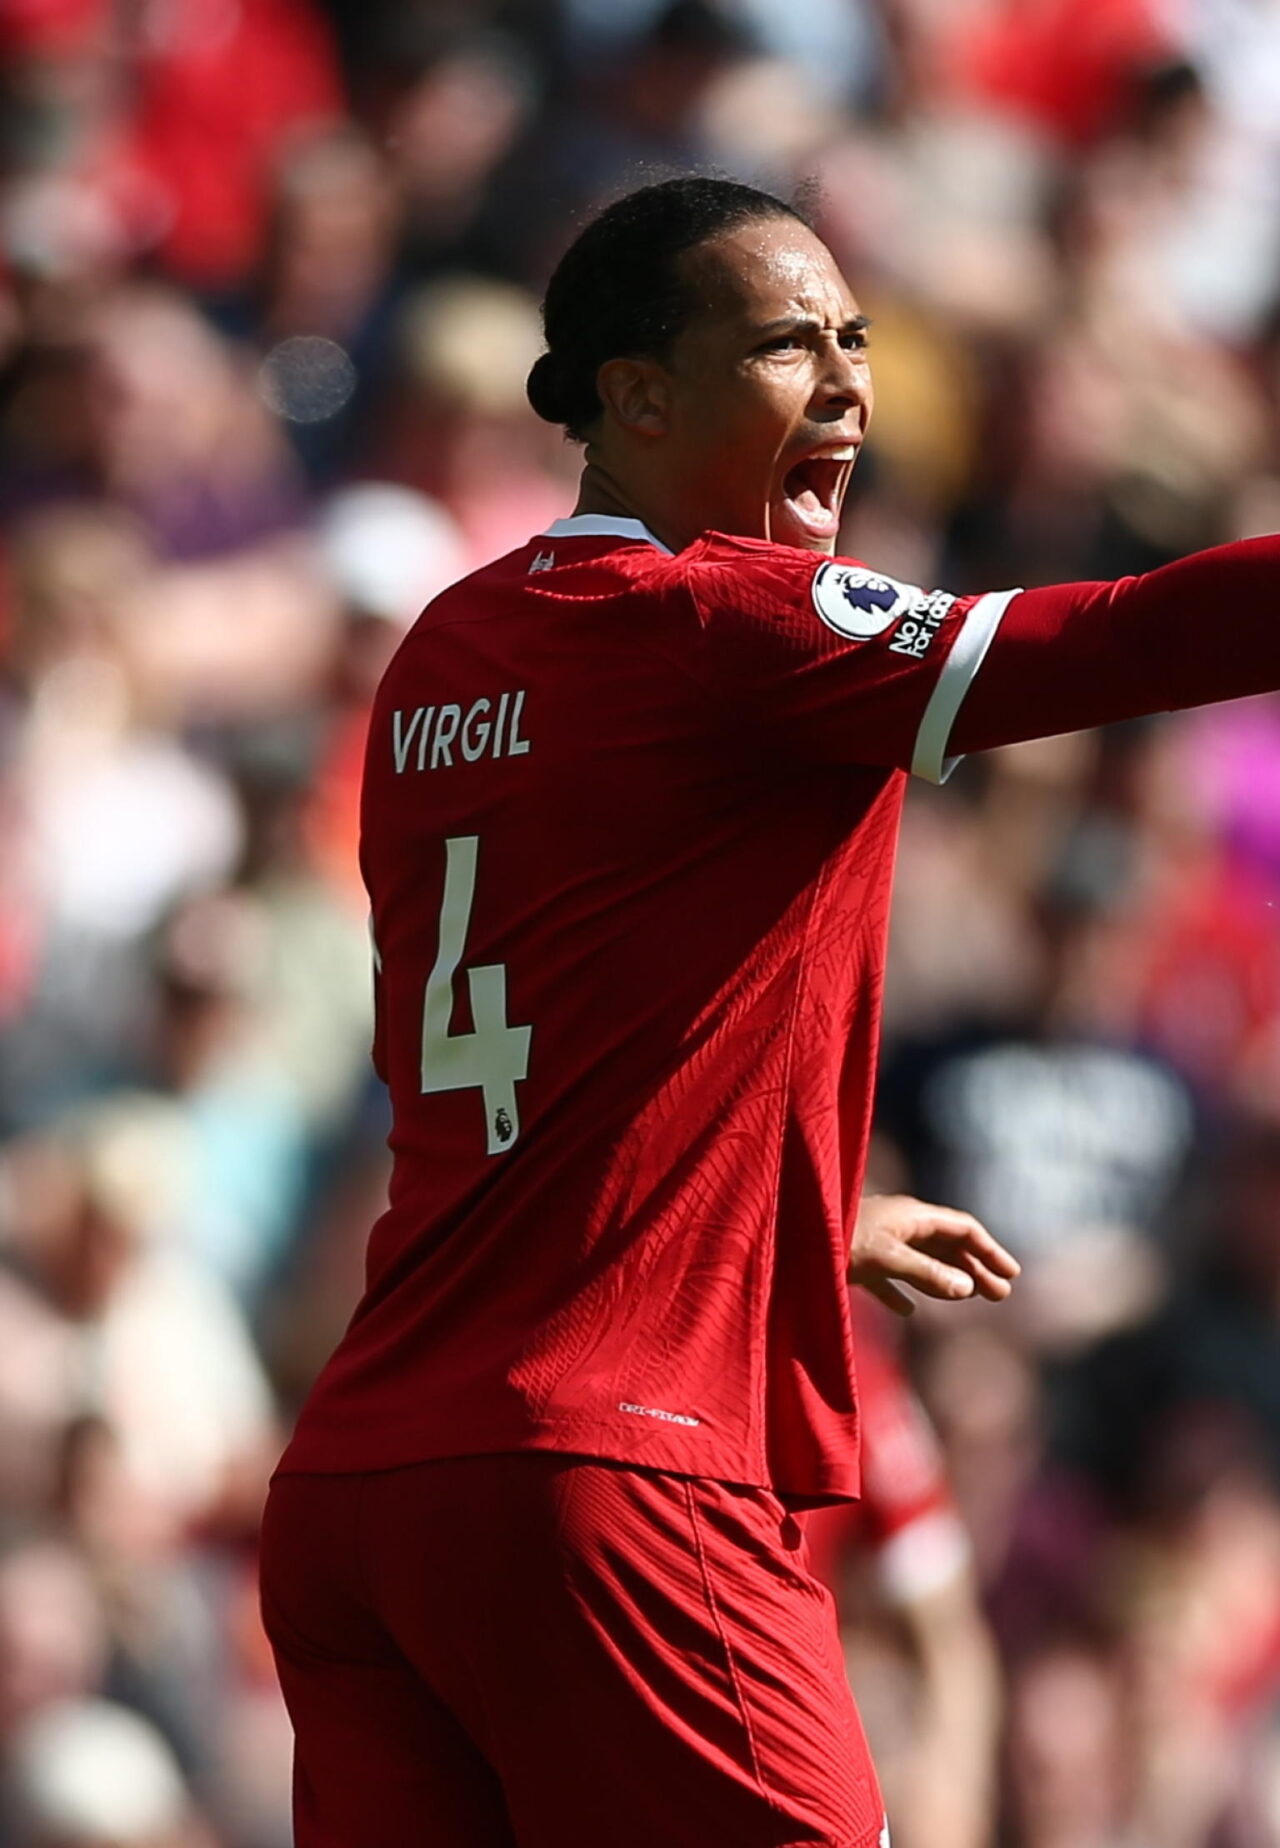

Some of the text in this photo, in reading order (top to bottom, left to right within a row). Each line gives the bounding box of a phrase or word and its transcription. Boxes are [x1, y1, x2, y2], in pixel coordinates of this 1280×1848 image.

[888, 621, 919, 654] No
[393, 690, 530, 774] VIRGIL
[421, 835, 532, 1155] 4
